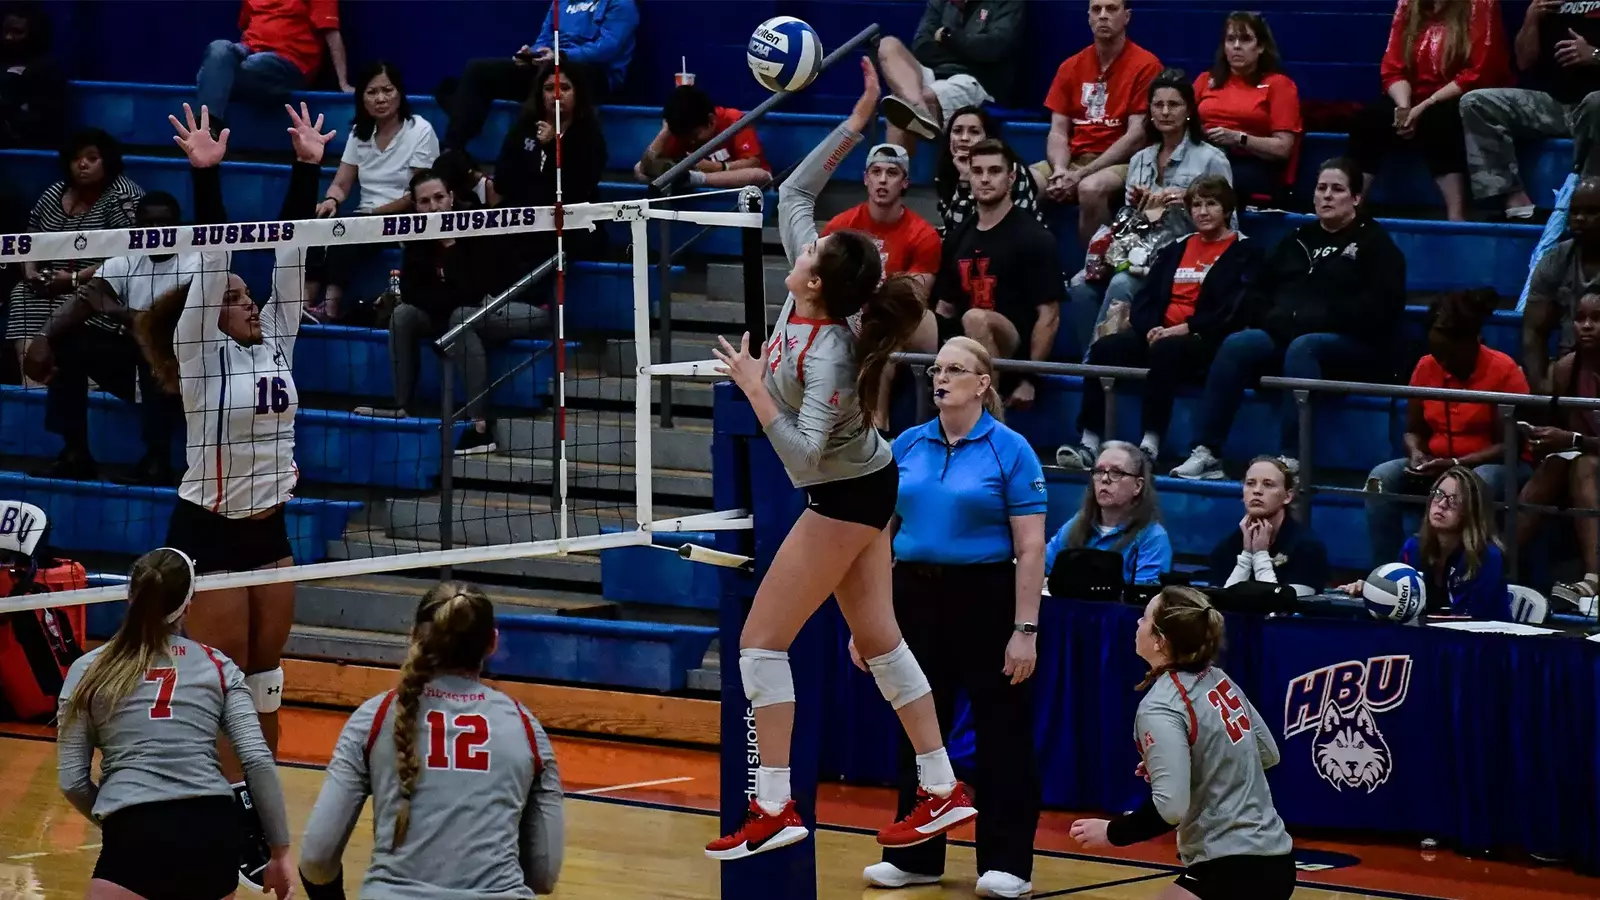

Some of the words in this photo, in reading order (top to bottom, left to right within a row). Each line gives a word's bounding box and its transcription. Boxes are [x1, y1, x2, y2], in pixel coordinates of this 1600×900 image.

[128, 228, 177, 249] HBU
[191, 222, 295, 246] HUSKIES
[382, 215, 428, 236] HBU
[440, 207, 536, 232] HUSKIES
[255, 376, 289, 415] 16
[143, 667, 178, 720] 7
[1205, 677, 1251, 745] 25
[1283, 655, 1413, 740] HBU
[425, 709, 491, 774] 12
